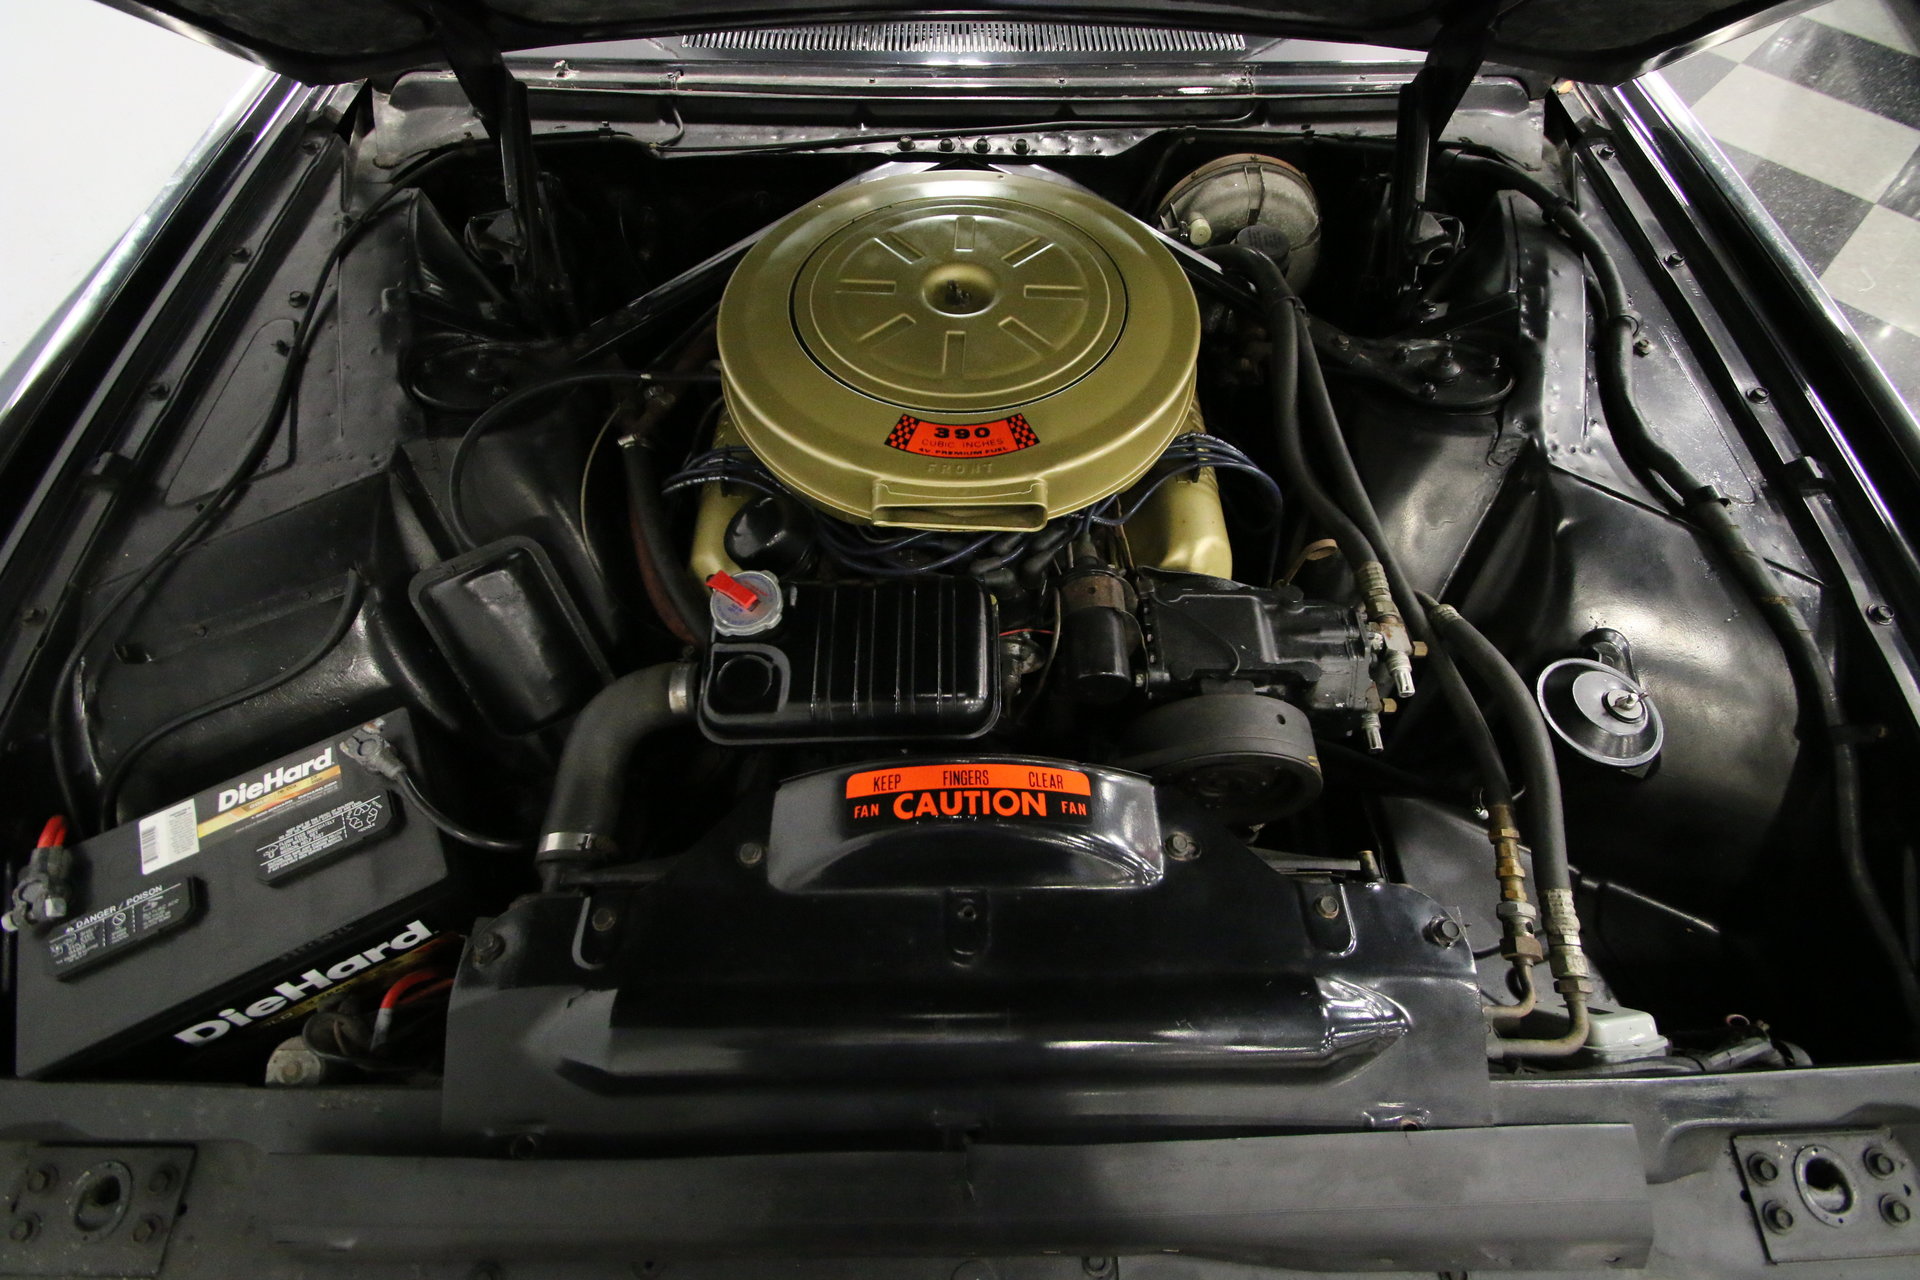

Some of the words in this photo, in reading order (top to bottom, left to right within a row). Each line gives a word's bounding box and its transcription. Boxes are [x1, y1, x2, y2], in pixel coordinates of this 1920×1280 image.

[921, 439, 955, 448] CUBIC
[962, 438, 1004, 448] INCHES
[934, 427, 991, 439] 390
[985, 446, 1009, 454] FUEL
[928, 462, 993, 474] FRONT
[218, 747, 332, 812] DieHard
[873, 774, 901, 792] KEEP
[943, 770, 989, 786] FINGERS
[1028, 771, 1064, 790] CLEAR
[854, 803, 879, 819] FAN
[893, 790, 1047, 820] CAUTION
[1061, 801, 1087, 816] FAN
[76, 905, 116, 929] DANGER
[126, 885, 163, 906] POISON
[174, 919, 433, 1047] DieHard
